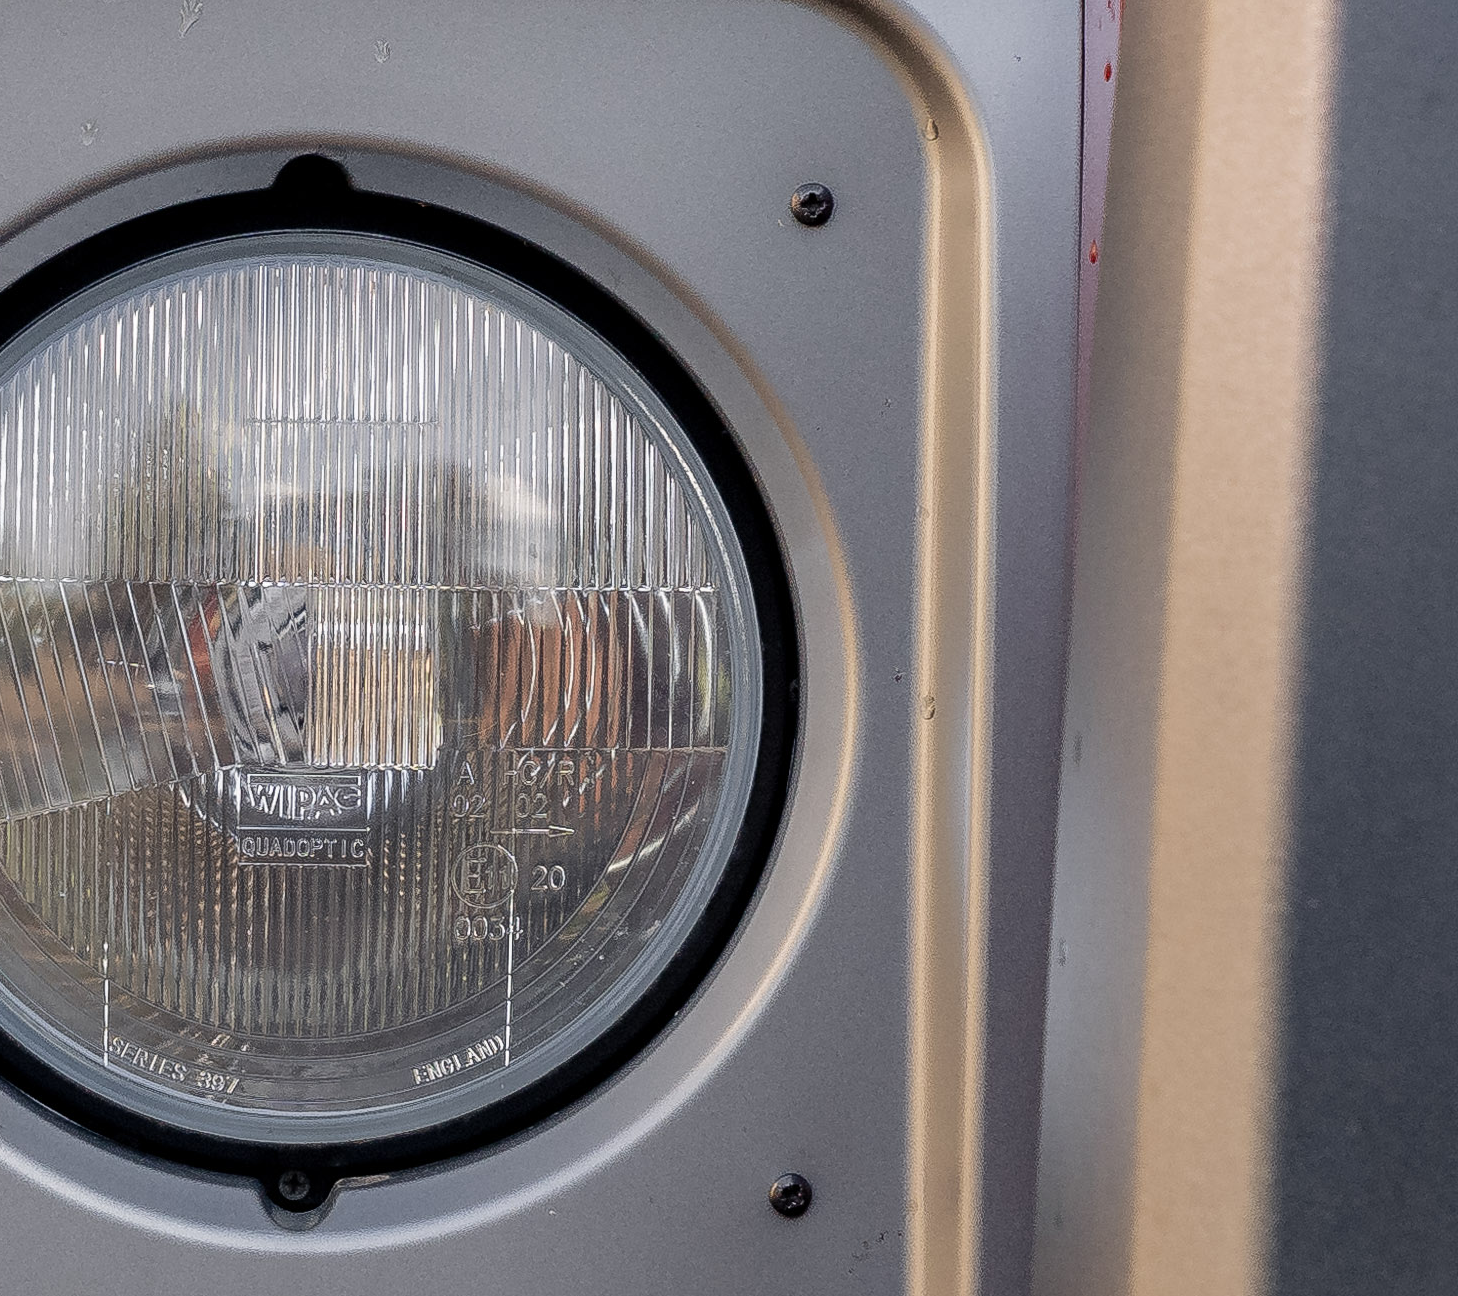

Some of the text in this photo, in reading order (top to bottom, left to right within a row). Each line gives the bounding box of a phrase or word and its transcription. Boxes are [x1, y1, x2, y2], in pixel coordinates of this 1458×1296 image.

[241, 836, 365, 858] QUADOPTIC
[531, 864, 566, 891] 20
[109, 1036, 189, 1082] SERIES
[412, 1034, 504, 1085] ENGLAND
